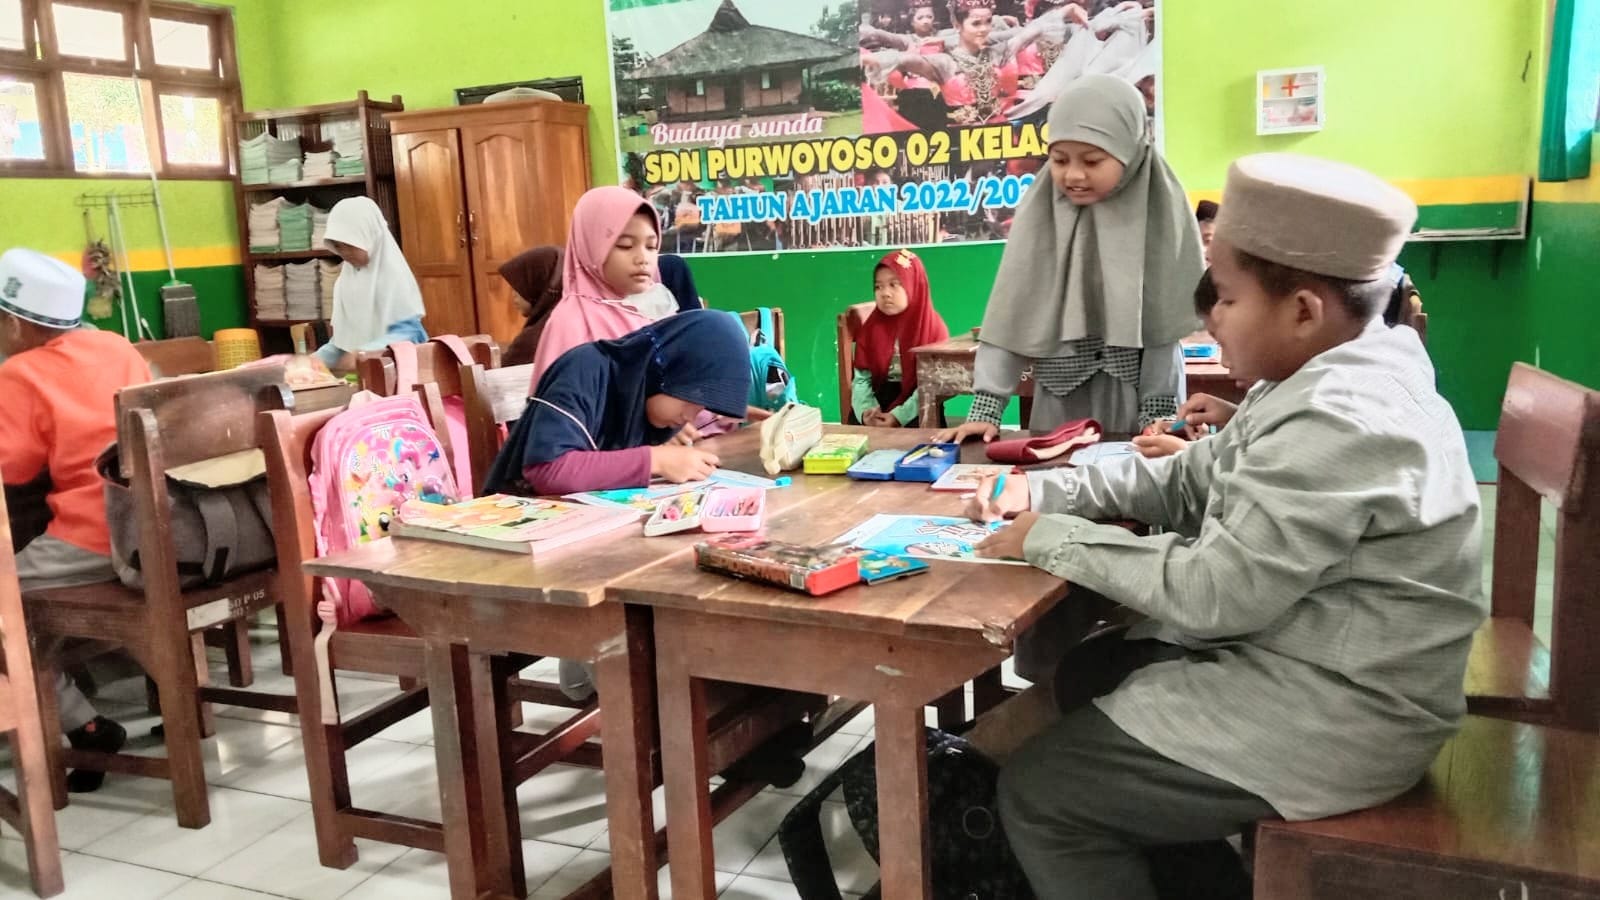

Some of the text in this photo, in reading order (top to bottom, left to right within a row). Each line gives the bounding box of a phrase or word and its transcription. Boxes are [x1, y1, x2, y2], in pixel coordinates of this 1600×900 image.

[650, 112, 823, 147] Budaya sunda
[644, 151, 701, 184] SDN
[707, 134, 898, 181] PURWOYOSO
[906, 130, 950, 166] 02
[698, 194, 786, 222] TAHUN
[791, 186, 897, 223] AJARAN
